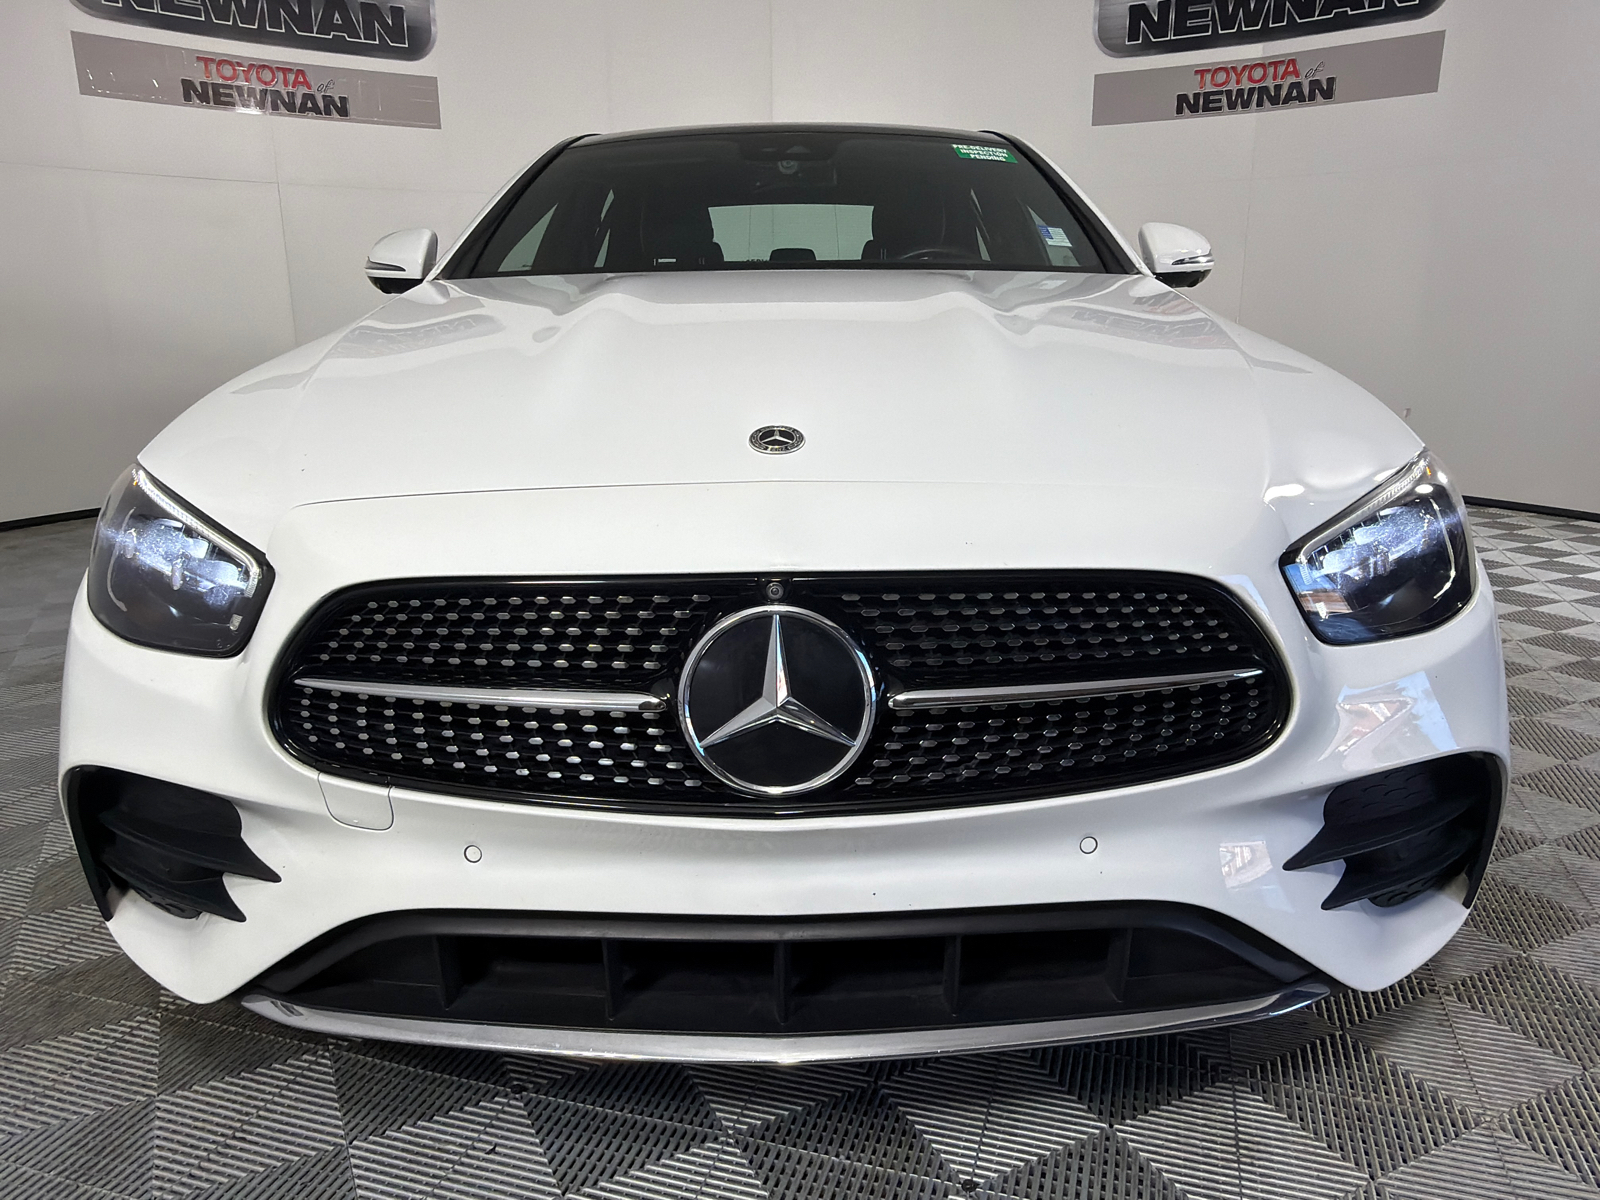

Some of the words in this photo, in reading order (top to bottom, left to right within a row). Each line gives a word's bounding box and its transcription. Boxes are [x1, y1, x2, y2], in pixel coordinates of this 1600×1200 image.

[101, 0, 409, 47] WNAN
[1126, 0, 1419, 45] NEWN
[196, 55, 312, 91] TOYOTA
[316, 79, 335, 94] of
[1194, 58, 1301, 90] TOYOTA
[1304, 61, 1326, 80] of
[180, 78, 350, 118] NEWNAN
[1174, 76, 1336, 117] NEWNAN
[960, 149, 1008, 158] INSPECTION
